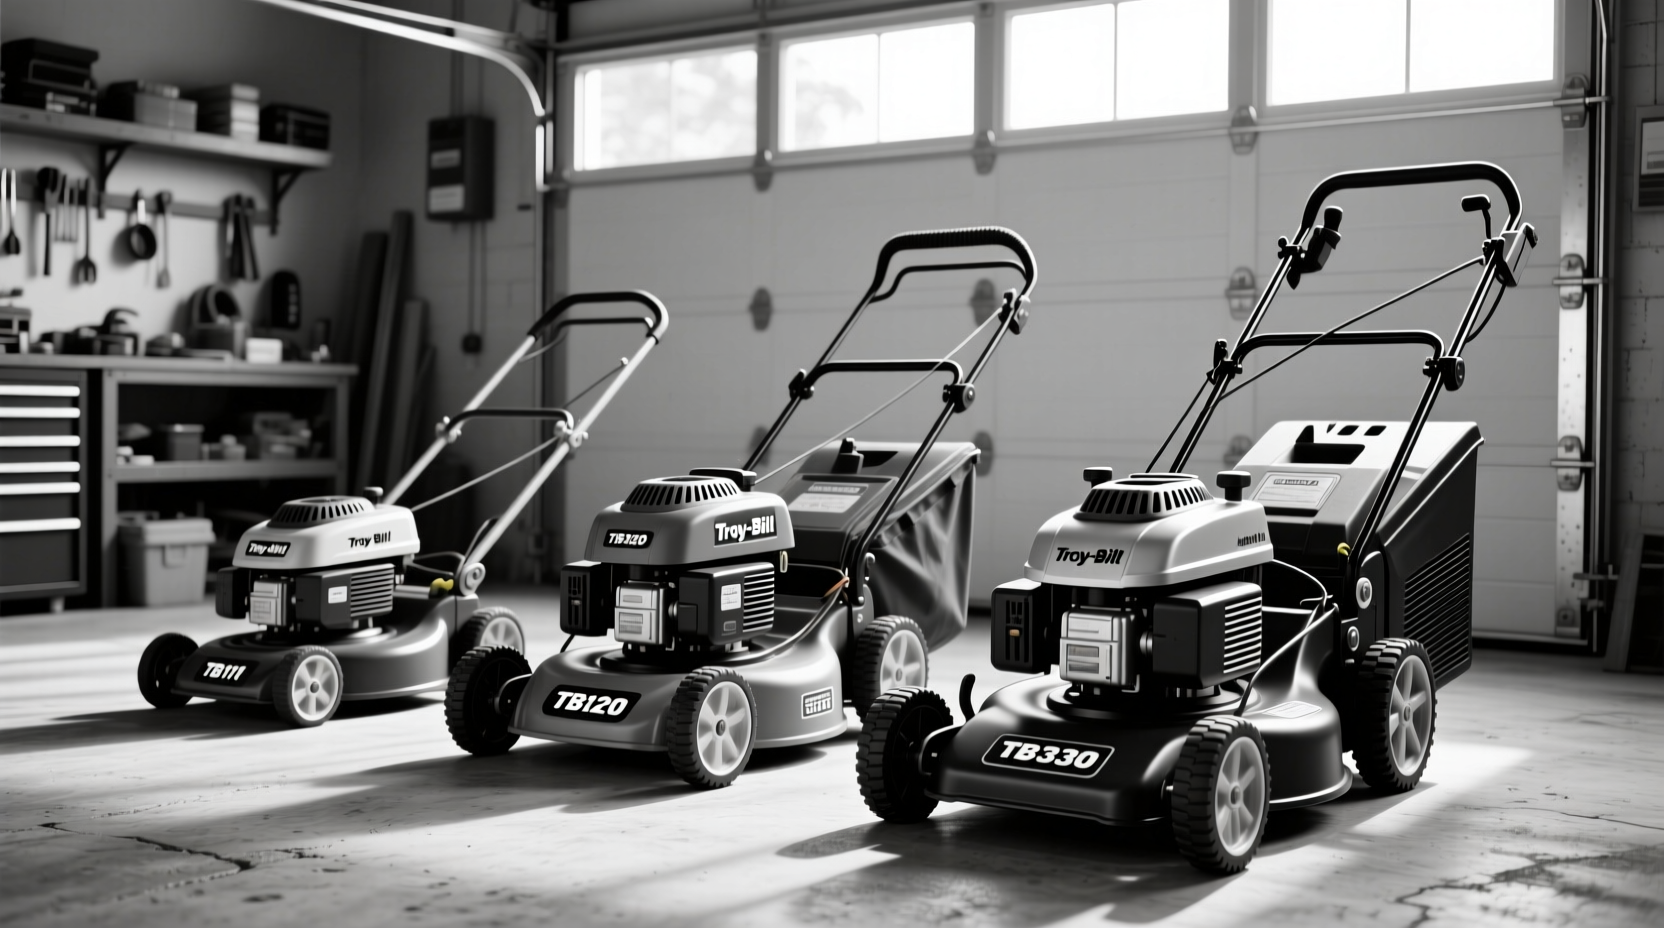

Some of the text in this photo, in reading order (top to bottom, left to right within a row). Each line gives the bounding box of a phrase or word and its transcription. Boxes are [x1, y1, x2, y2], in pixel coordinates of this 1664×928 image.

[715, 514, 775, 542] Troy-Bill
[1056, 547, 1125, 567] Troy-Bill
[553, 690, 629, 717] TB120
[1000, 740, 1100, 770] TB330
